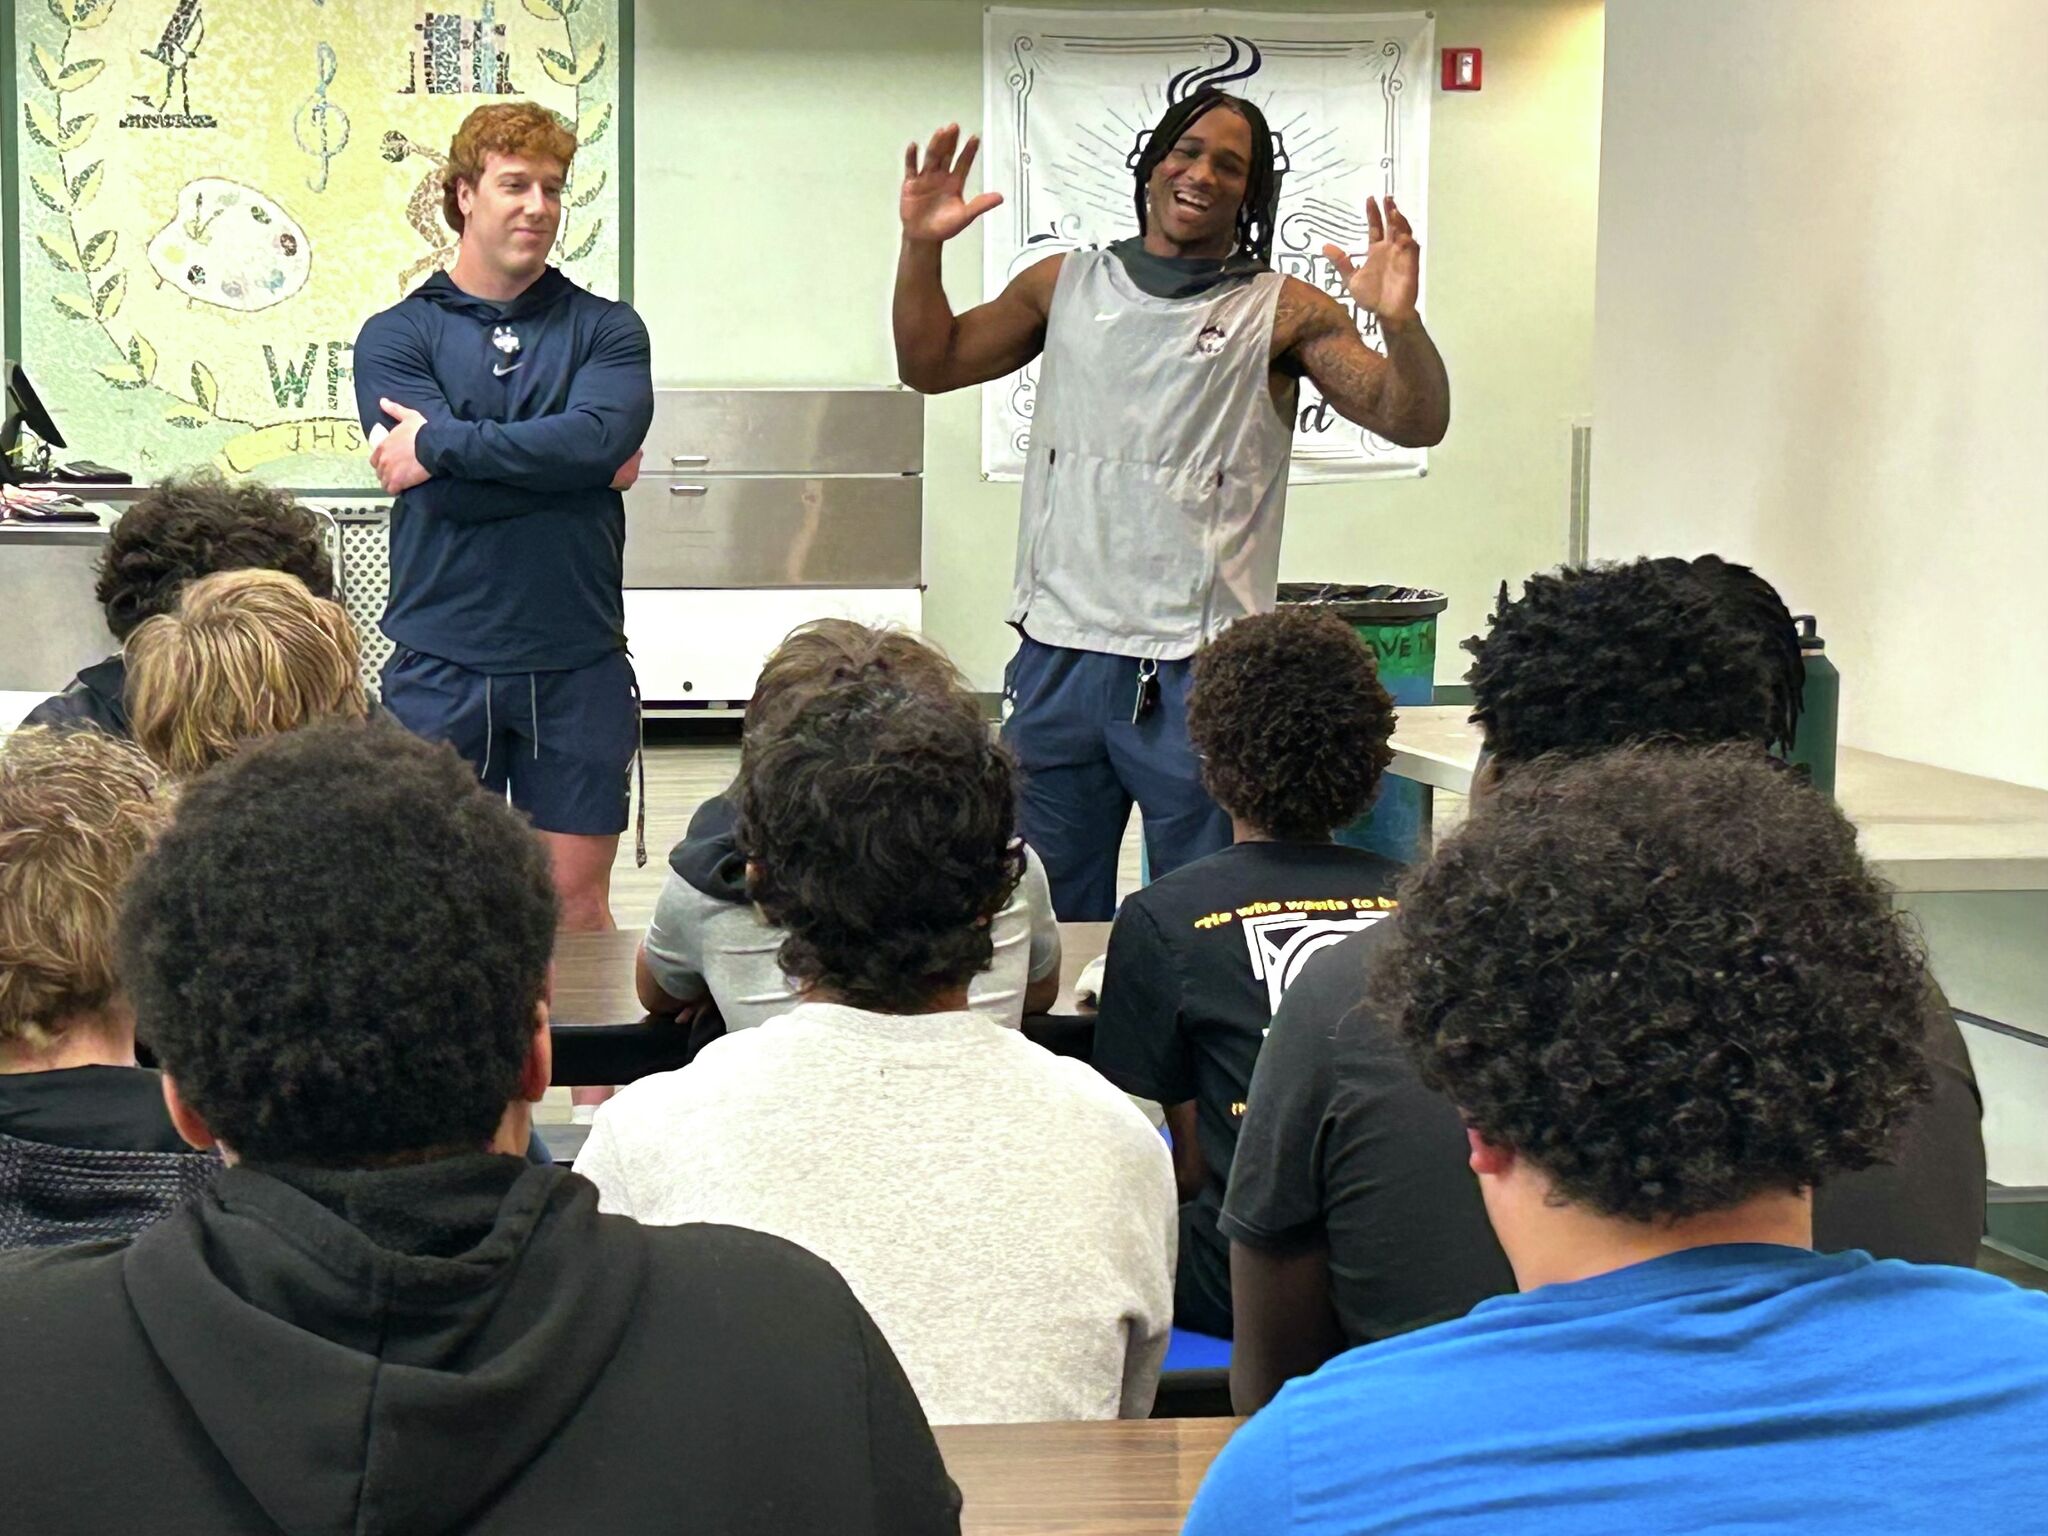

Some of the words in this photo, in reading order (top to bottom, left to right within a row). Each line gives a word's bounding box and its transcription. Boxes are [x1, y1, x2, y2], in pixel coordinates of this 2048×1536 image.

[286, 424, 361, 451] JHS
[1236, 901, 1281, 917] who
[1285, 899, 1348, 911] wants
[1351, 897, 1374, 909] to
